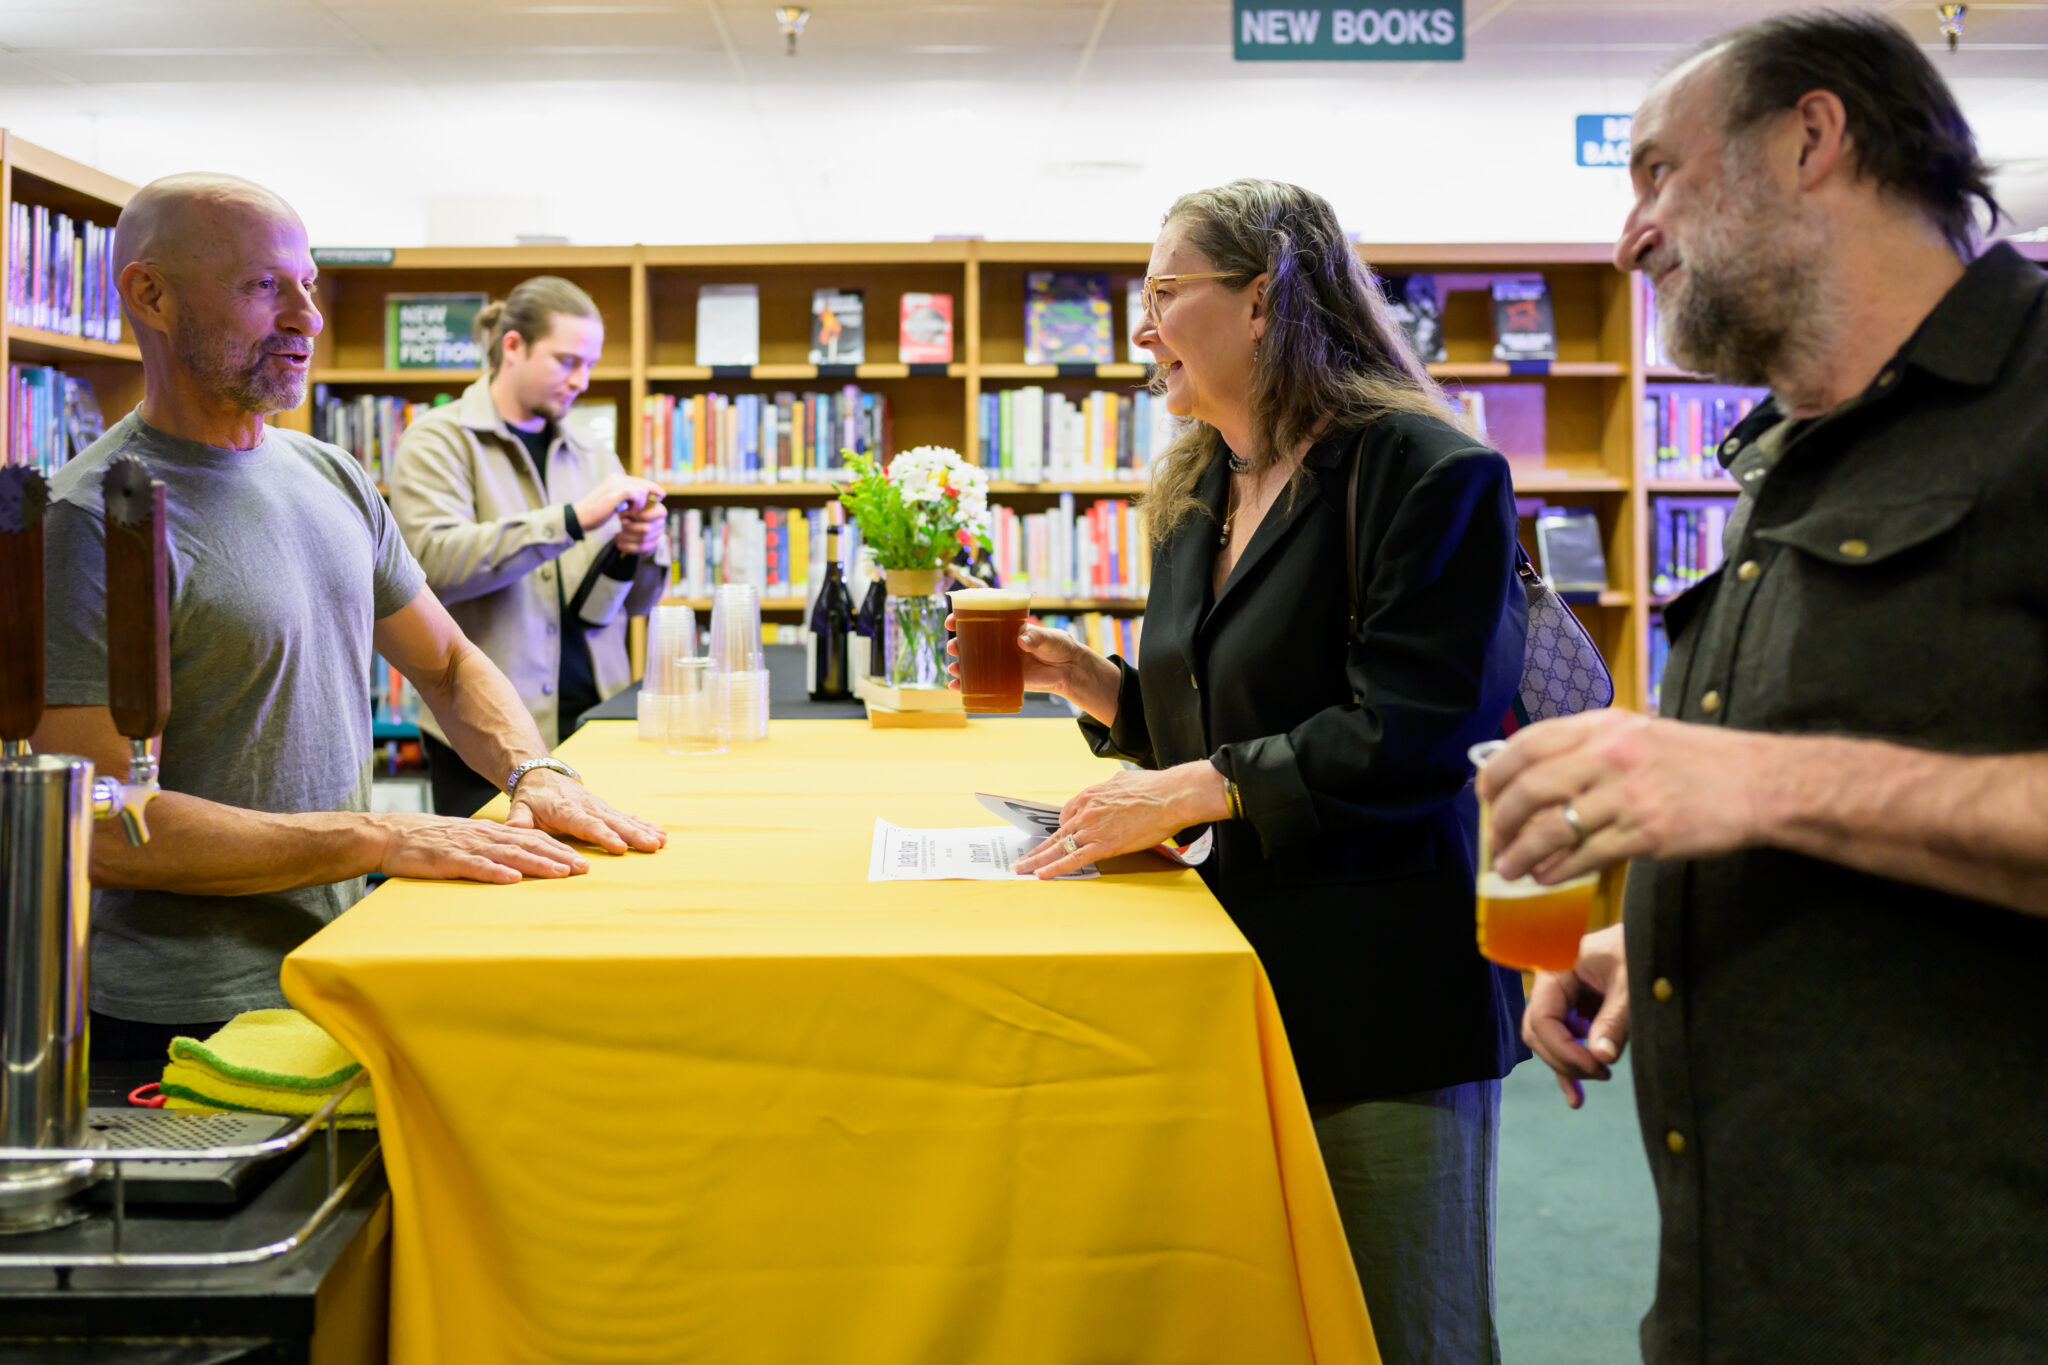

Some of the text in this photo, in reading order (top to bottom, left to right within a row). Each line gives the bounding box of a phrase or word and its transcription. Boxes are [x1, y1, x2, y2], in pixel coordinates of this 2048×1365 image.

[1241, 8, 1456, 46] NEW BOOKS
[401, 304, 448, 323] NEW
[401, 342, 482, 363] FICTION
